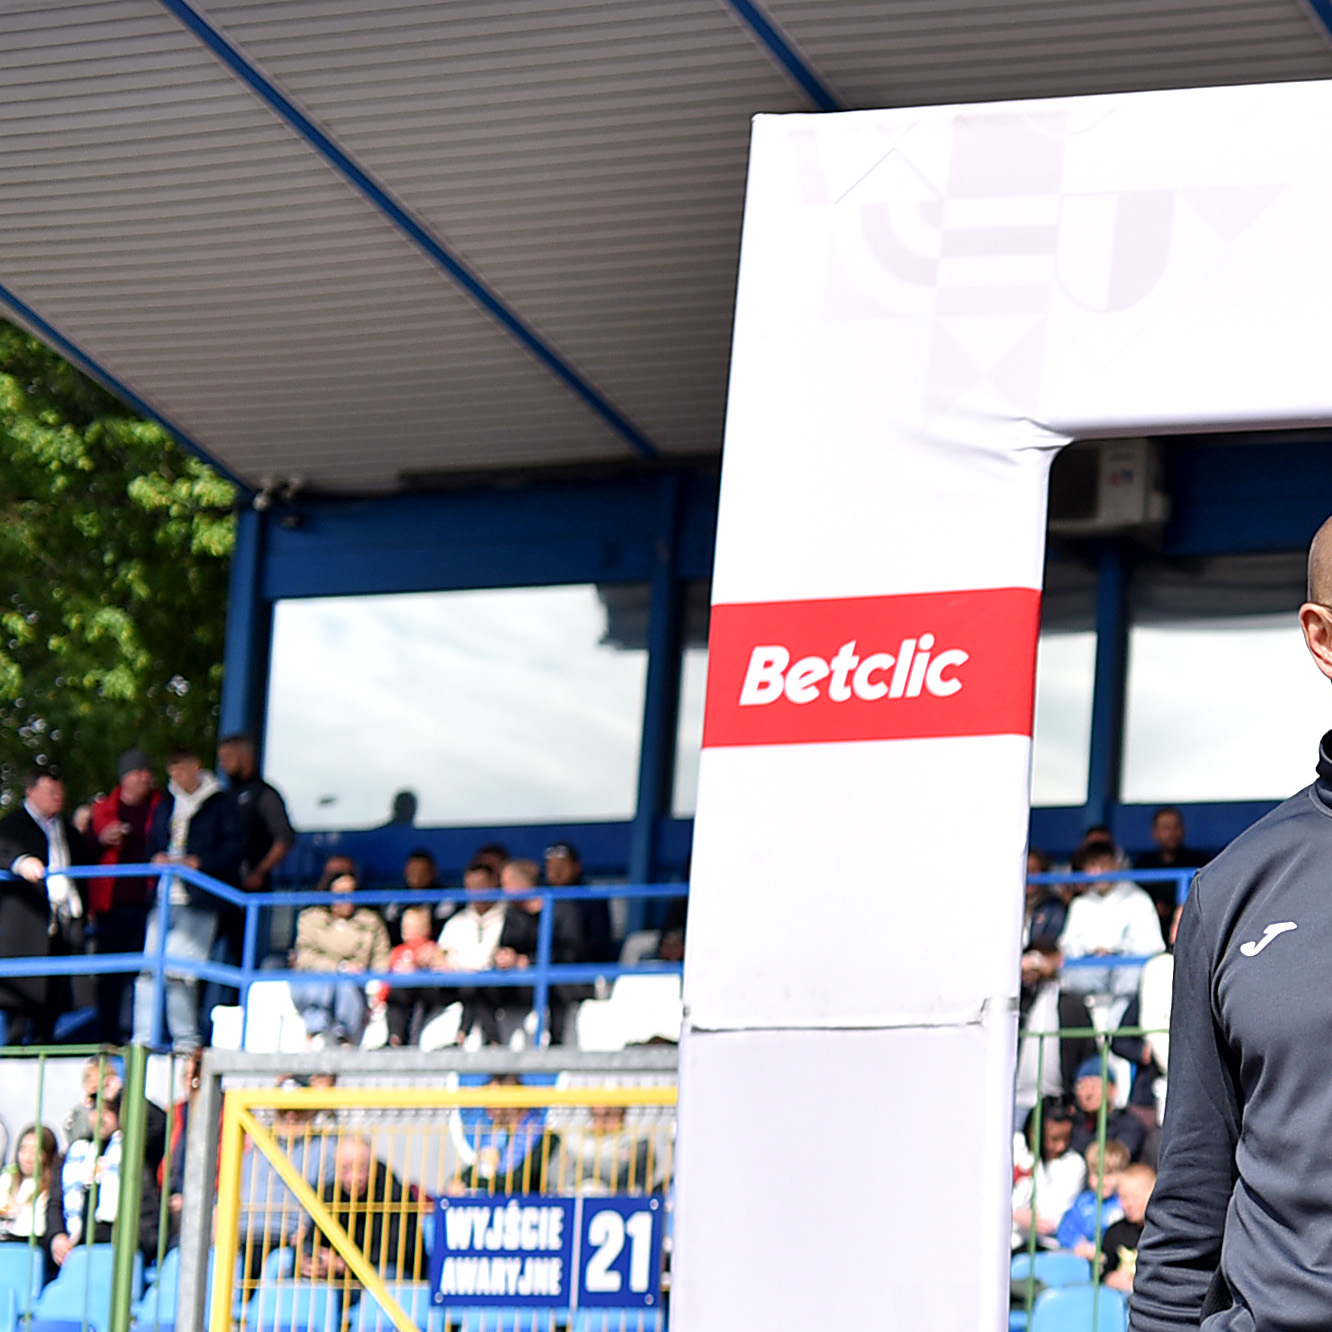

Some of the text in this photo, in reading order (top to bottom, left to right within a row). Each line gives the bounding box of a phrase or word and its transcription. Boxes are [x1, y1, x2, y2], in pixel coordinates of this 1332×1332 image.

[739, 633, 970, 706] Betclic
[445, 1199, 653, 1293] WYJŚCIE 21
